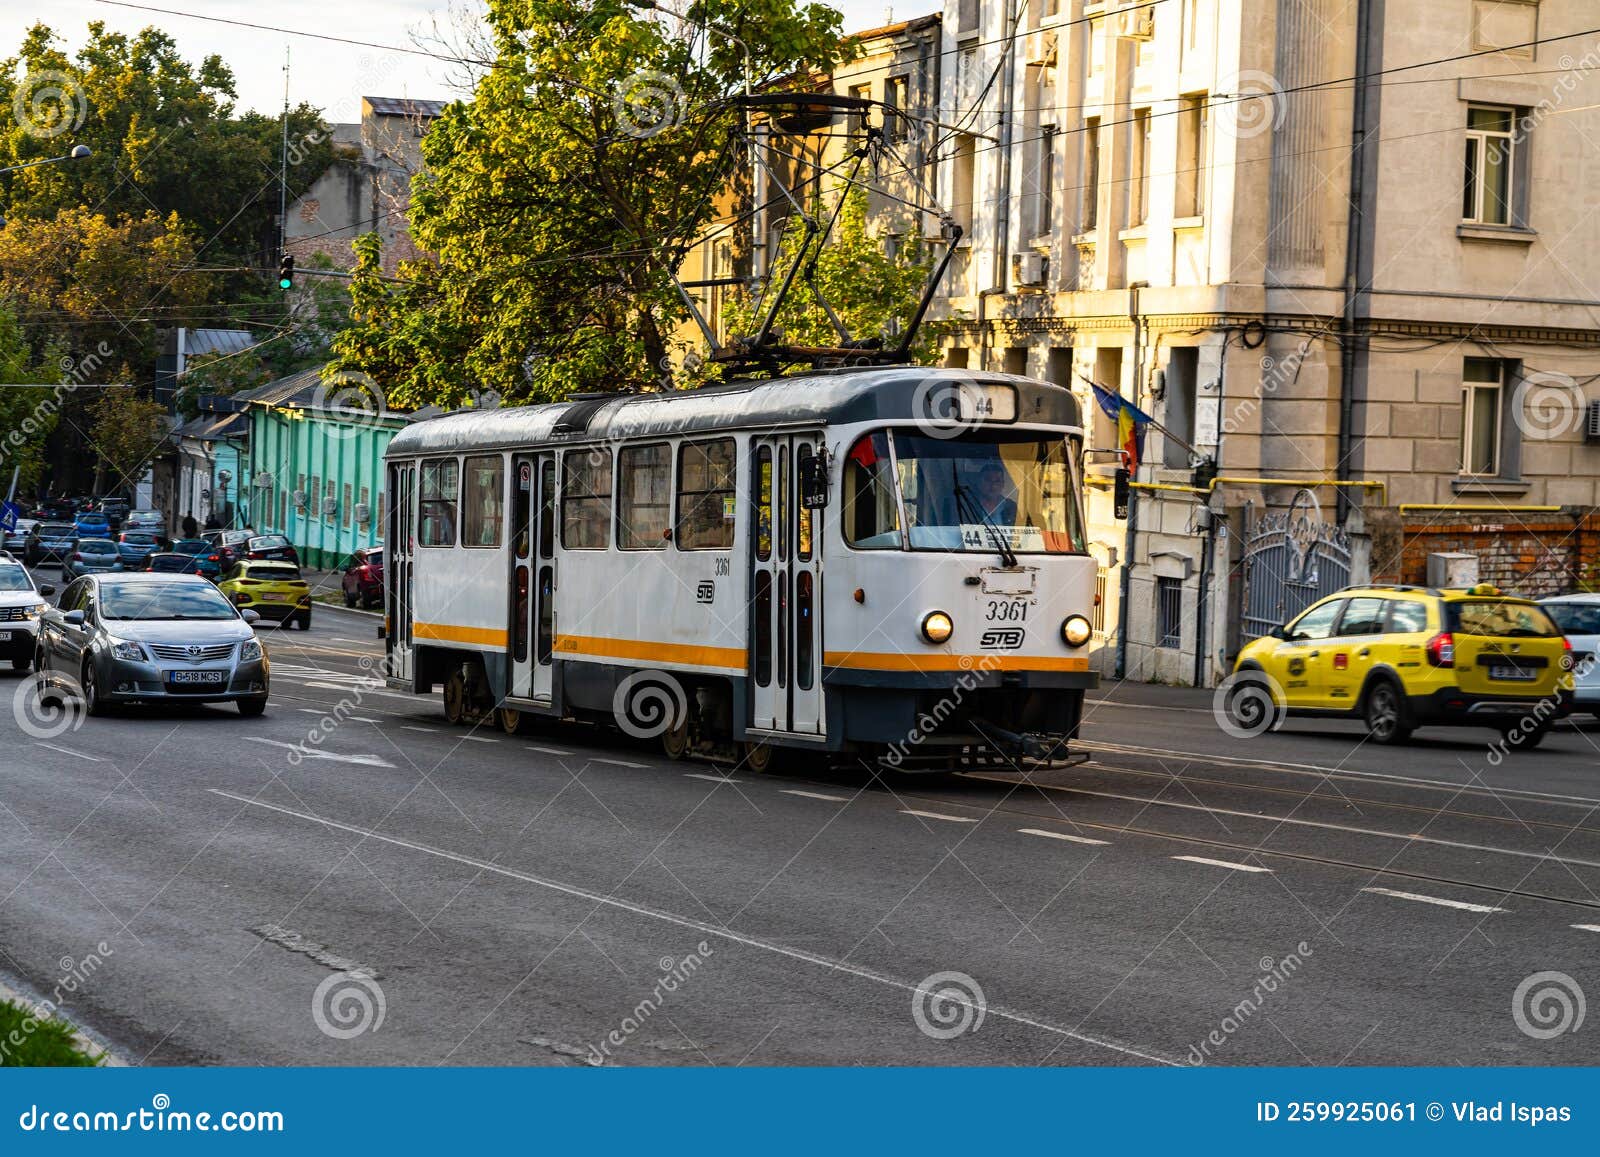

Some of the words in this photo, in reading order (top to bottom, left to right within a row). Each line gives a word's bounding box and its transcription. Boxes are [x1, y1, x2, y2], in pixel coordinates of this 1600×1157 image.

[976, 398, 993, 415] 44
[965, 531, 982, 546] 44
[715, 557, 730, 577] 3361
[697, 583, 714, 600] STB
[986, 601, 1027, 621] 3361
[980, 630, 1022, 647] STB
